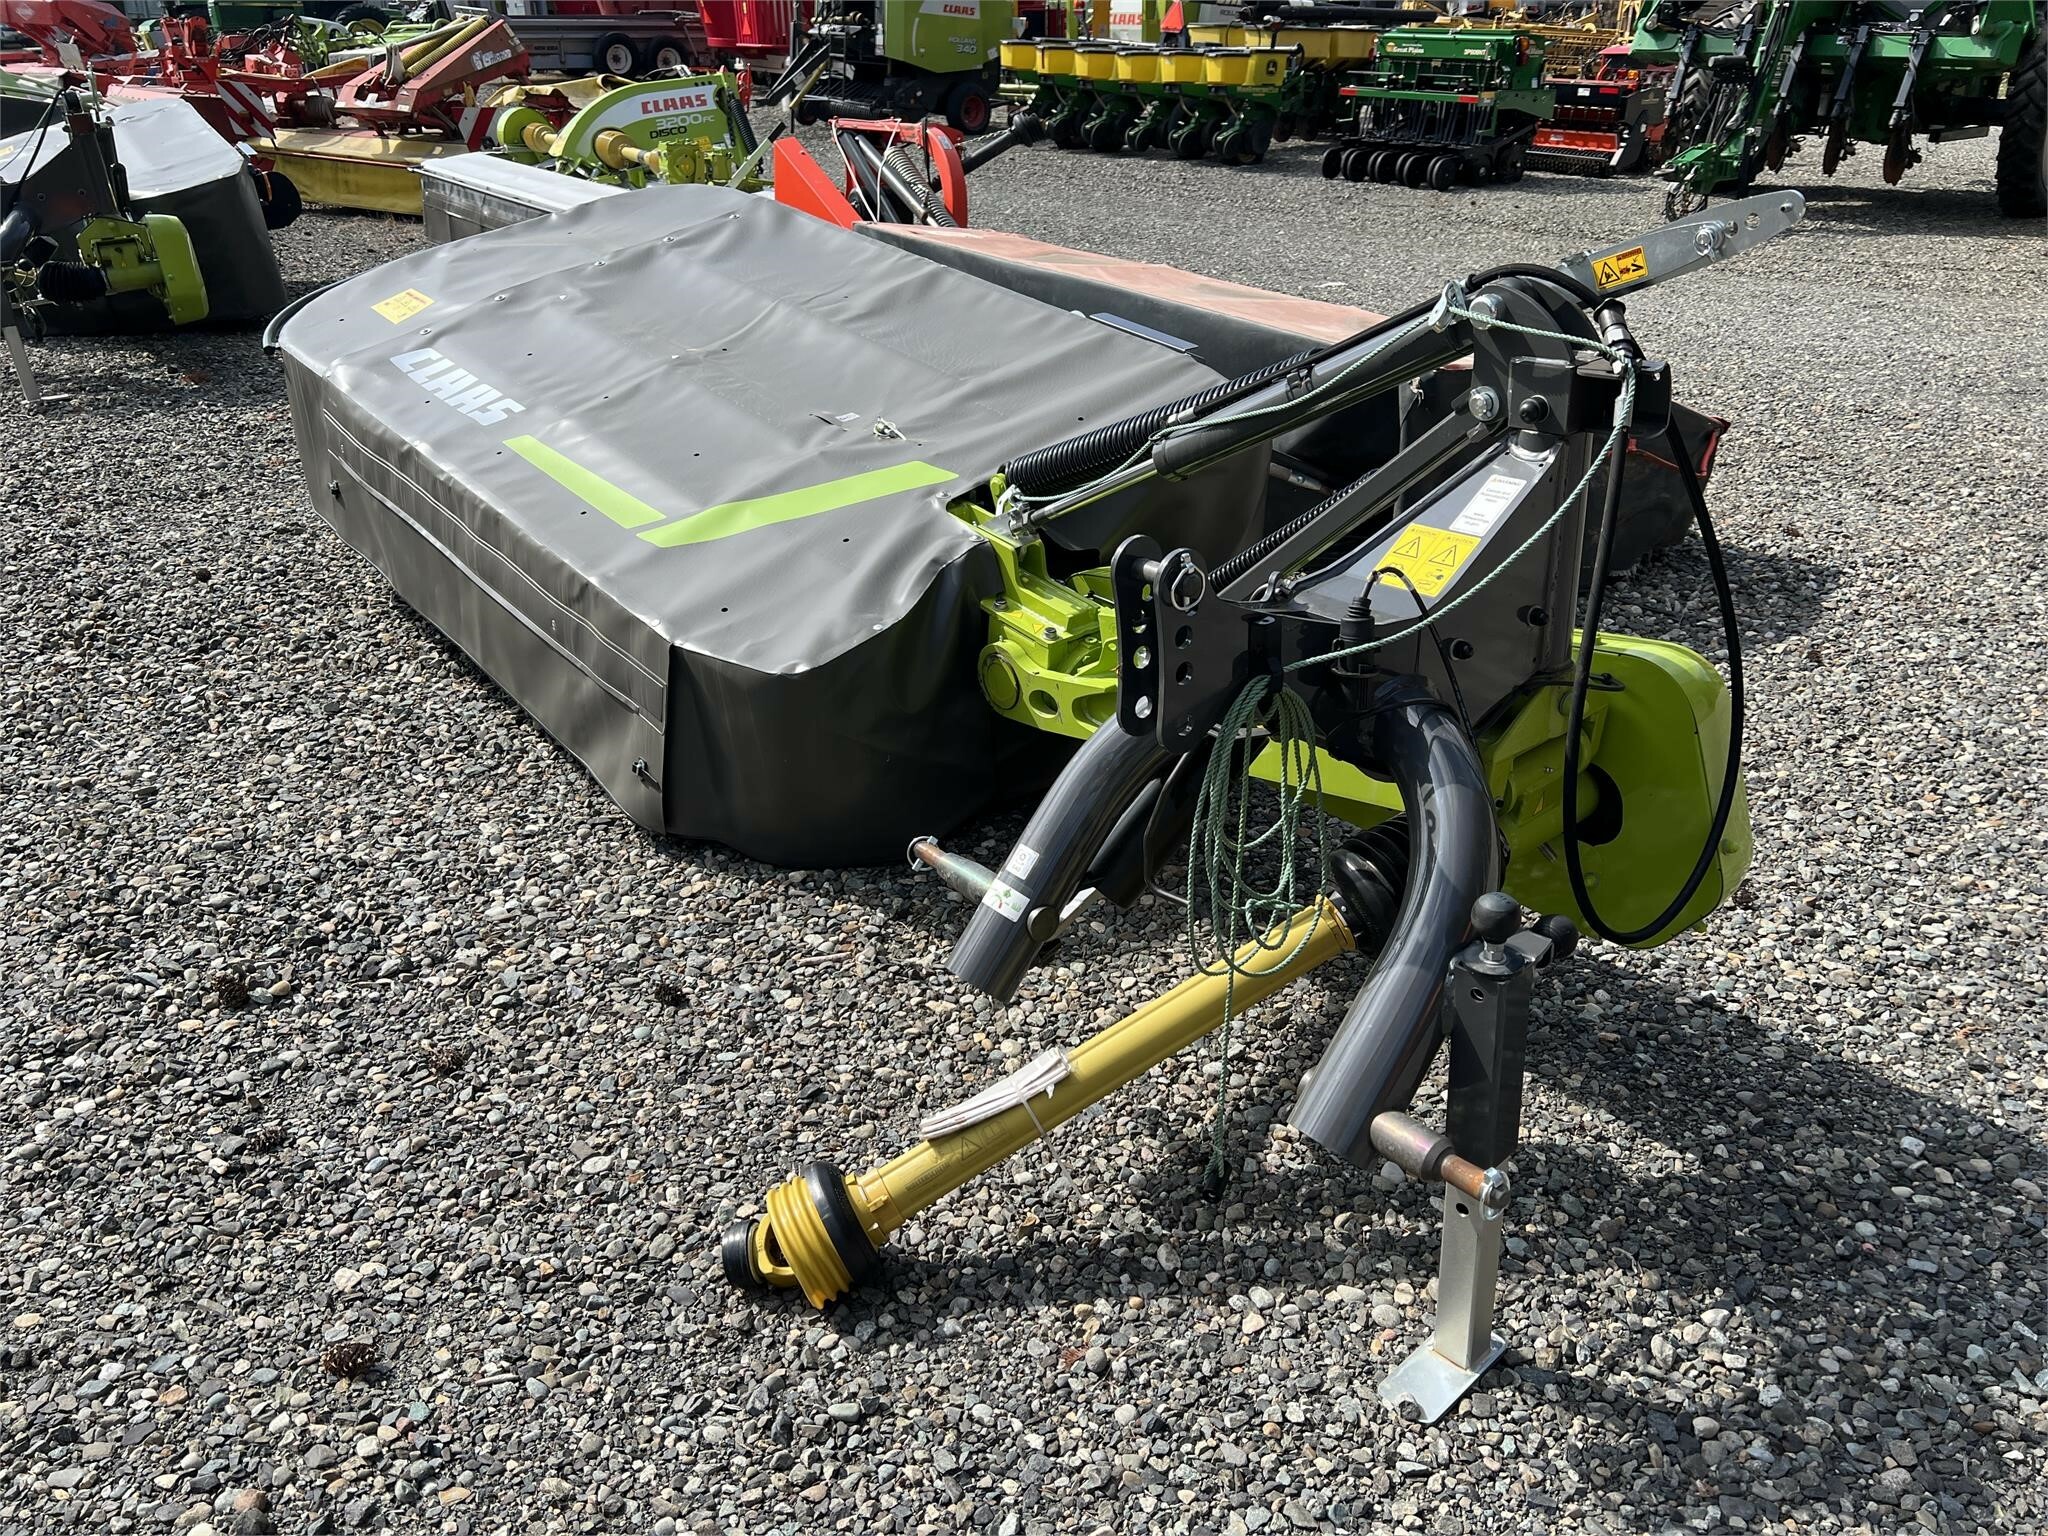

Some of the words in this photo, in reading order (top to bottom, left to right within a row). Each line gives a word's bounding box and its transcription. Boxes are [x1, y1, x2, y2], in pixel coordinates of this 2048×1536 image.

[943, 4, 976, 16] CLAAS
[1408, 46, 1425, 55] Plains
[641, 93, 708, 115] CLAAS
[656, 113, 702, 130] 3200
[649, 126, 687, 139] DISCO
[389, 347, 527, 427] CLAAS
